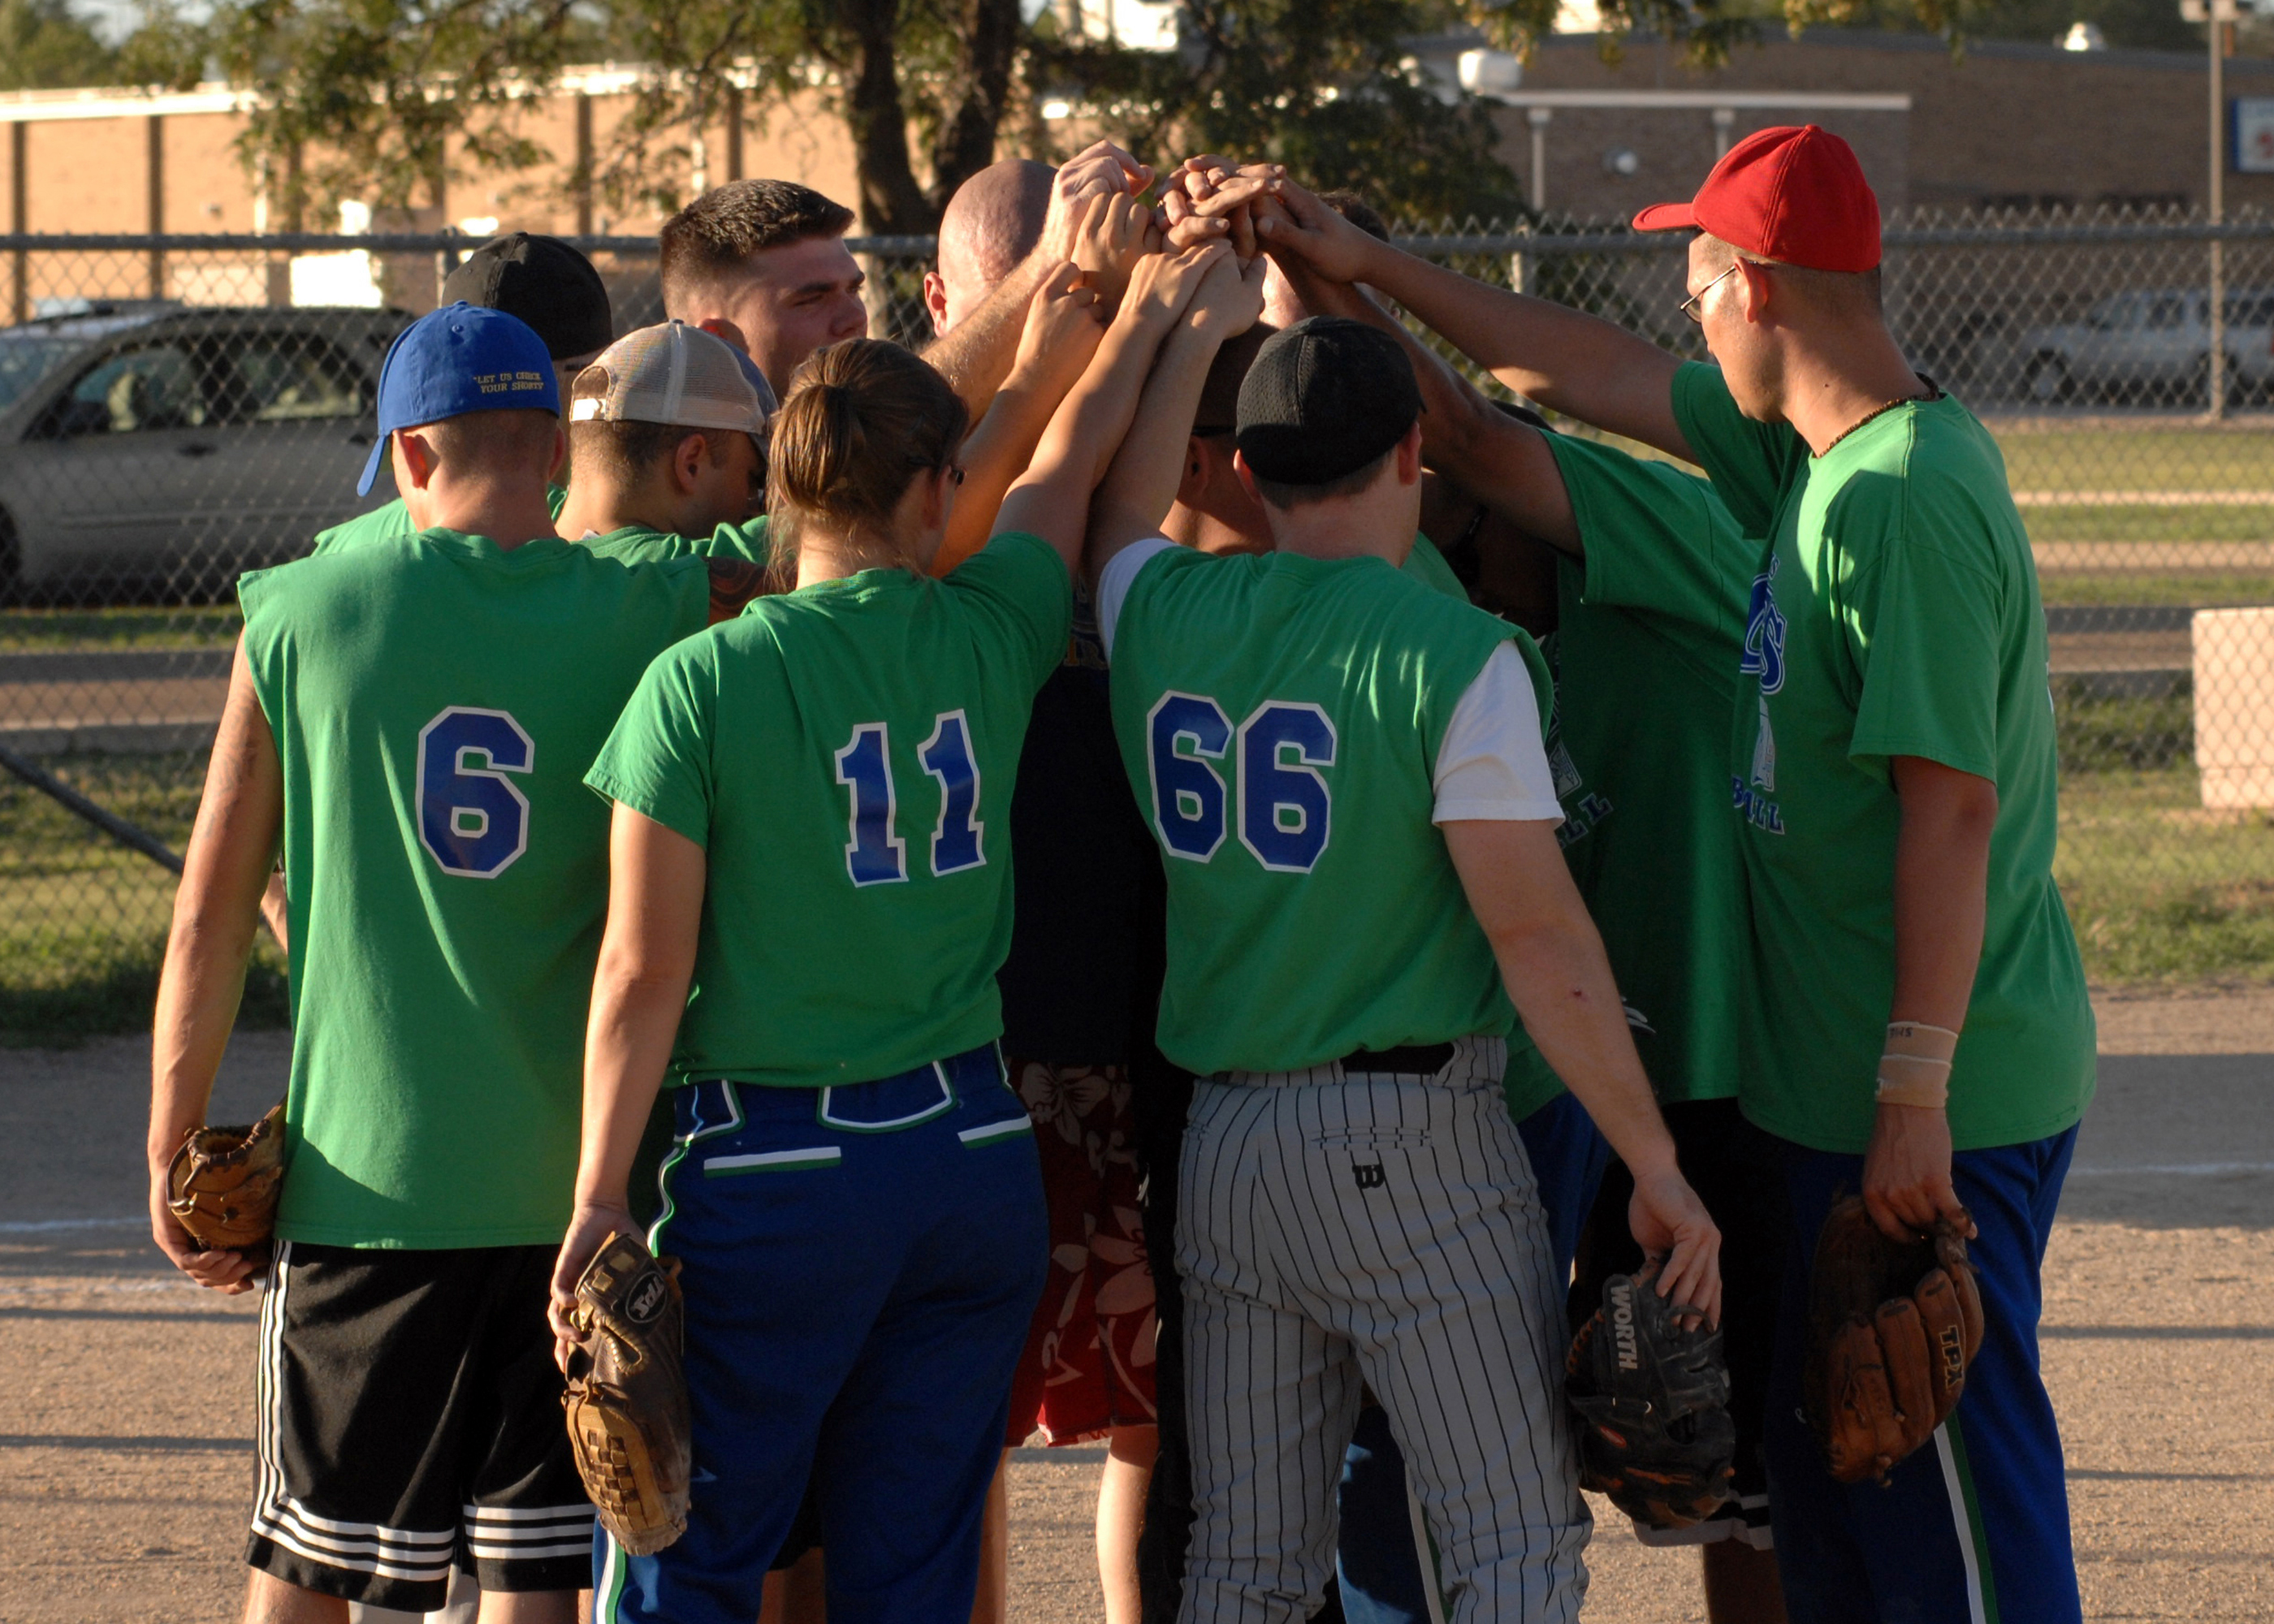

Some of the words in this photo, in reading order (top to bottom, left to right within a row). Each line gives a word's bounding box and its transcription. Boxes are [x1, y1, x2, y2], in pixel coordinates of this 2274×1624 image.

[481, 382, 508, 394] YOUR
[499, 373, 512, 382] US
[516, 371, 541, 381] CHECK
[415, 706, 535, 879] 6
[834, 708, 987, 888] 11
[1147, 689, 1338, 875] 66
[1559, 793, 1615, 849] LL
[1610, 1284, 1638, 1370] WORTH
[1939, 1324, 1965, 1389] TPX
